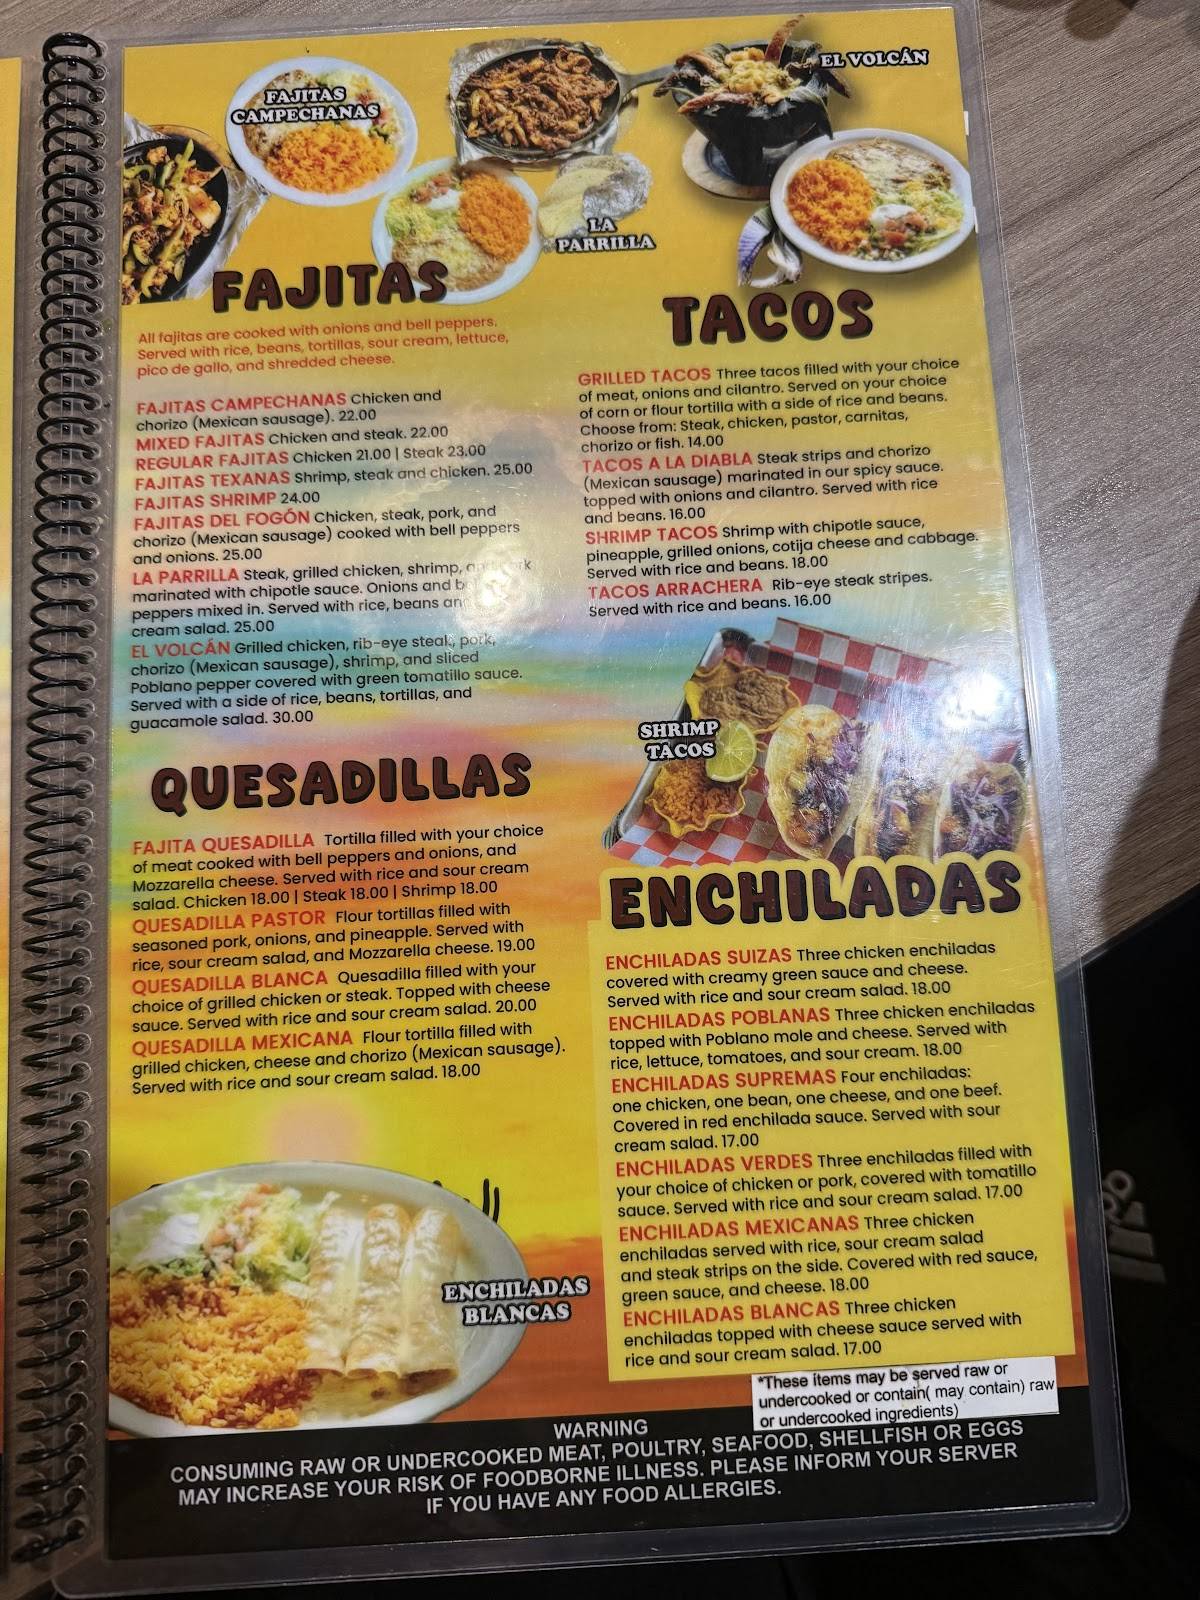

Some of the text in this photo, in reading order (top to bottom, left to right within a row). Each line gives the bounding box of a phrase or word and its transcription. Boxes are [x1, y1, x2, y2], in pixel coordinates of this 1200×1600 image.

[820, 47, 929, 67] EL VOLCÁN
[265, 87, 346, 104] FAJITAS
[231, 105, 380, 124] CAMPECHANAS
[588, 218, 616, 232] LA
[557, 235, 655, 252] PARRILLA
[212, 261, 448, 314] FAJITAS
[137, 332, 155, 344] All
[157, 330, 203, 346] fajitas
[205, 330, 231, 341] are
[232, 325, 286, 340] cooked
[288, 323, 319, 337] with
[322, 322, 370, 335] onions
[373, 319, 402, 333] and
[405, 318, 431, 330] bell
[662, 290, 874, 346] TACOS
[577, 357, 960, 386] GRILLED TACOS Three tacos filled with your choice
[136, 388, 442, 415] FAJITAS CAMPECHANAS Chicken and
[136, 425, 448, 451] MIXED FAJITAS Chicken and steak. 22.00
[580, 434, 724, 453] chorizo or fish. 14.00
[582, 444, 931, 473] TACOS A LA DIABLA Steak strips and chorizo
[135, 462, 533, 491] FAJITAS TEXANAS Shrimp, steak and chicken. 25.00
[134, 504, 496, 531] FAJITAS DEL FOGÓN Chicken, steak, pork, and
[588, 571, 932, 599] TACOS ARRACHERA Rib-eye steak stripes.
[130, 668, 522, 695] Poblano pepper covered with green tomatillo sauce.
[640, 721, 719, 739] SHRIMP
[647, 742, 715, 759] TACOS
[151, 753, 532, 817] QUESADILLAS
[133, 823, 544, 855] FAJITA QUESADILLA Tortilla filled with your choice
[610, 861, 1021, 929] ENCHILADAS
[132, 901, 510, 935] QUESADILLA PASTOR Flour tortillas filled with
[605, 941, 996, 970] ENCHILADAS SUIZAS Three chicken enchiladas
[611, 1065, 971, 1094] ENCHILADAS SUPREMAS Four enchiladas:
[619, 1211, 974, 1242] ENCHILADAS MEXICANAS Three chicken
[444, 1278, 588, 1301] ENCHILADAS
[464, 1303, 570, 1325] BLANCAS
[812, 1372, 852, 1387] items
[855, 1372, 886, 1386] may
[889, 1368, 908, 1382] be
[912, 1362, 960, 1382] served
[964, 1365, 990, 1378] raw
[993, 1363, 1008, 1375] or
[758, 1389, 852, 1409] undercooked
[855, 1391, 870, 1403] or
[934, 1386, 964, 1400] may
[968, 1378, 1025, 1396] contain)
[1029, 1379, 1055, 1391] raw
[553, 1418, 648, 1440] WARNING
[759, 1402, 960, 1428] or undercooked ingredients)
[170, 1419, 1023, 1483] CONSUMING RAW OR UNDERCOOKED MEAT, POULTRY, SEAFOOD, SHELLFISH OR EGGS
[178, 1442, 1018, 1506] MAY INCREASE YOUR RISK OF FOODBORNE ILLNESS. PLEASE INFORM YOUR SERVER
[426, 1478, 781, 1514] IF YOU HAVE ANY FOOD ALLERGIES.
